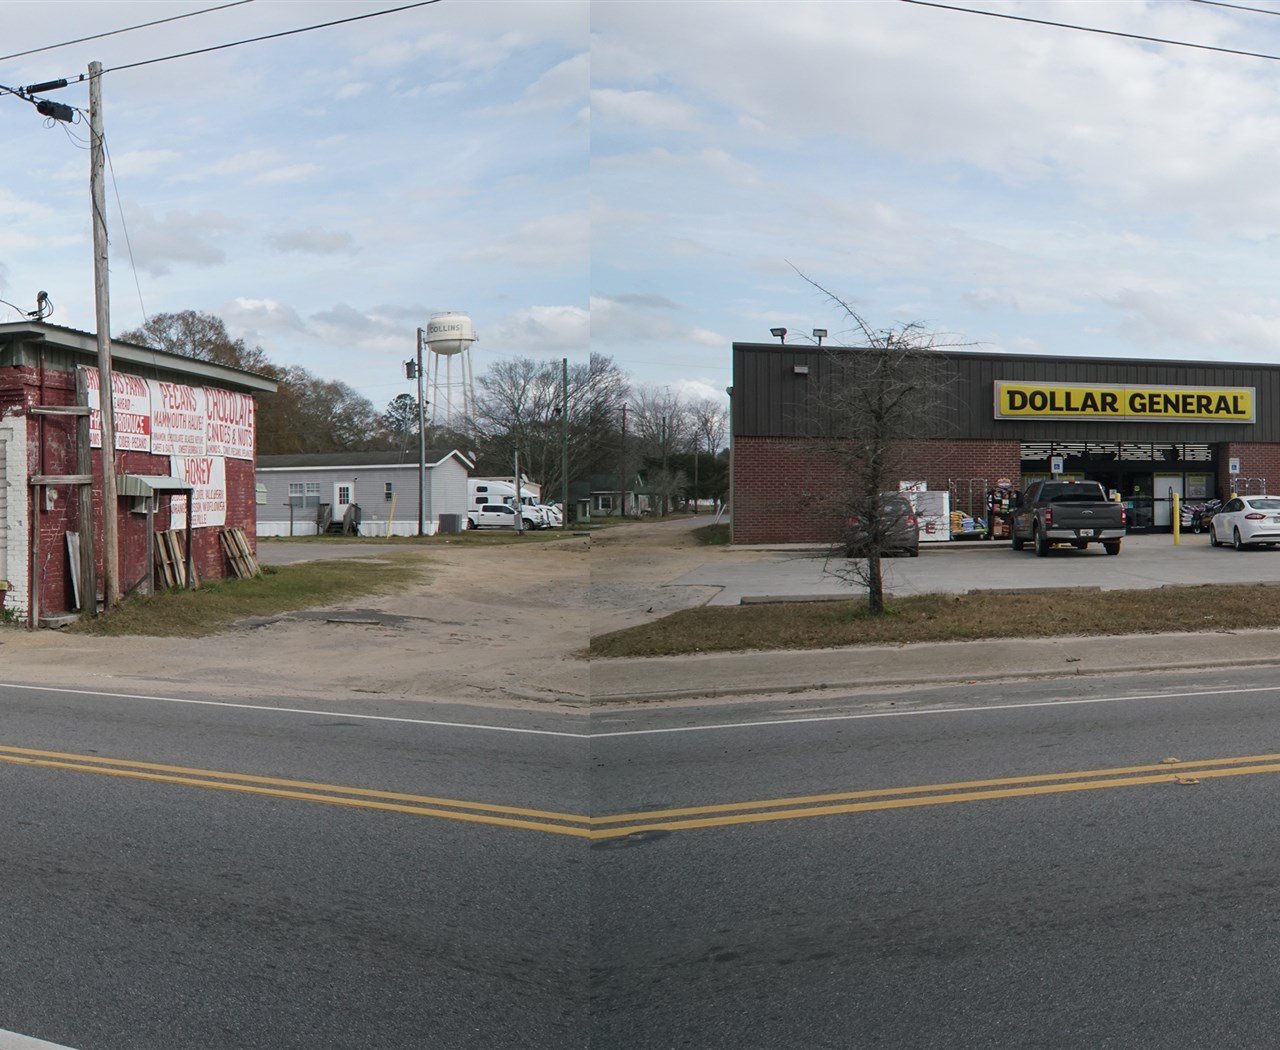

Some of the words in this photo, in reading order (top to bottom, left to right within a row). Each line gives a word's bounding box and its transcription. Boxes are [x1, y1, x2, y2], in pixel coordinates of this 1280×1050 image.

[430, 324, 460, 333] COLLINS
[159, 382, 197, 411] PECANS
[205, 387, 253, 427] CHOCOLATE
[1006, 390, 1119, 413] DOLLAR
[1129, 392, 1246, 415] GENERAL
[114, 412, 145, 434] PRODUCE
[184, 458, 213, 485] HONEY
